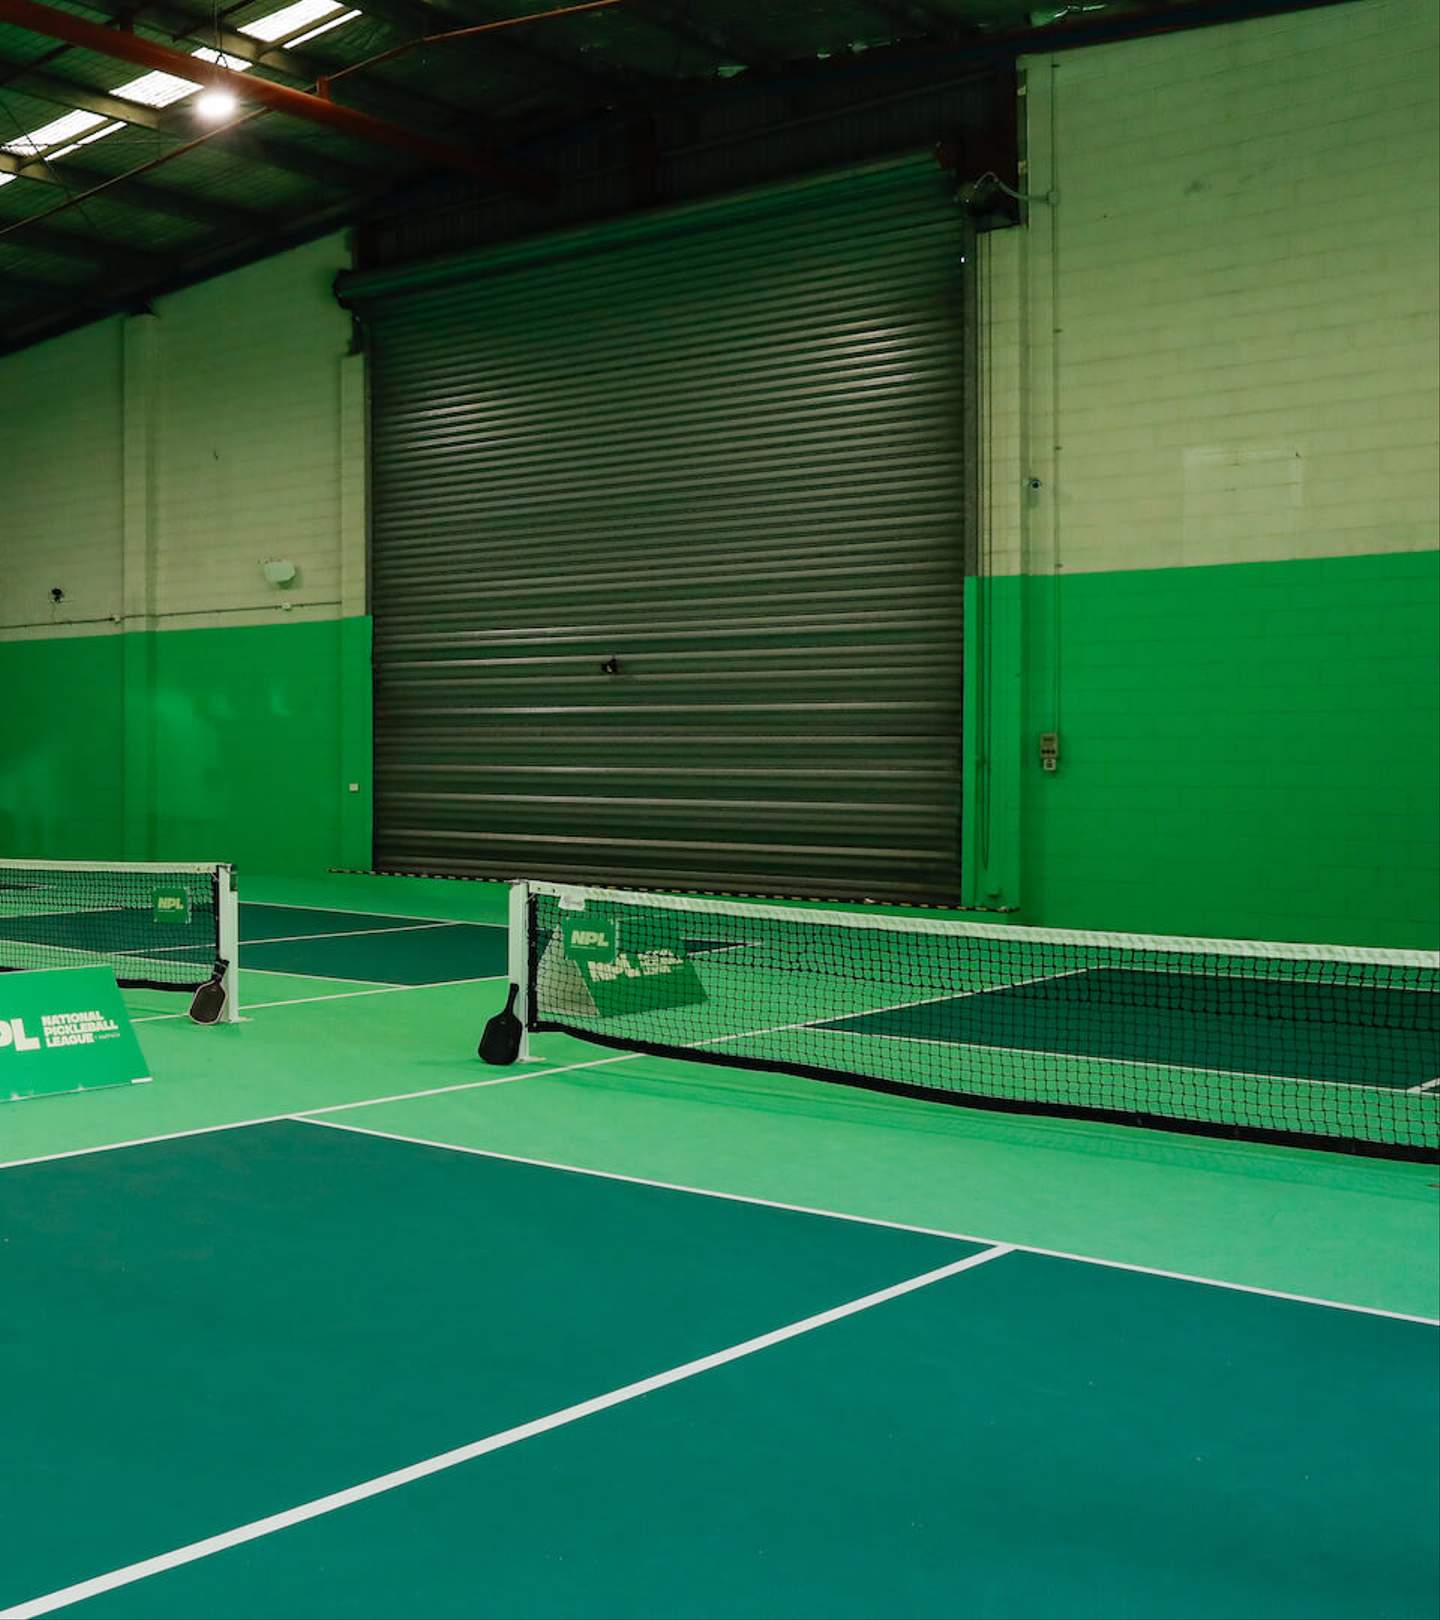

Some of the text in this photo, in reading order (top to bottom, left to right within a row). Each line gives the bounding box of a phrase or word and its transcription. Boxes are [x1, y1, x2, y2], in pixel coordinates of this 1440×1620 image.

[158, 897, 184, 910] NPL
[571, 930, 609, 947] NPL
[41, 1010, 104, 1026] NATIONAL
[44, 1019, 119, 1038] PICKLEBALL
[46, 1033, 95, 1048] LEAGUE
